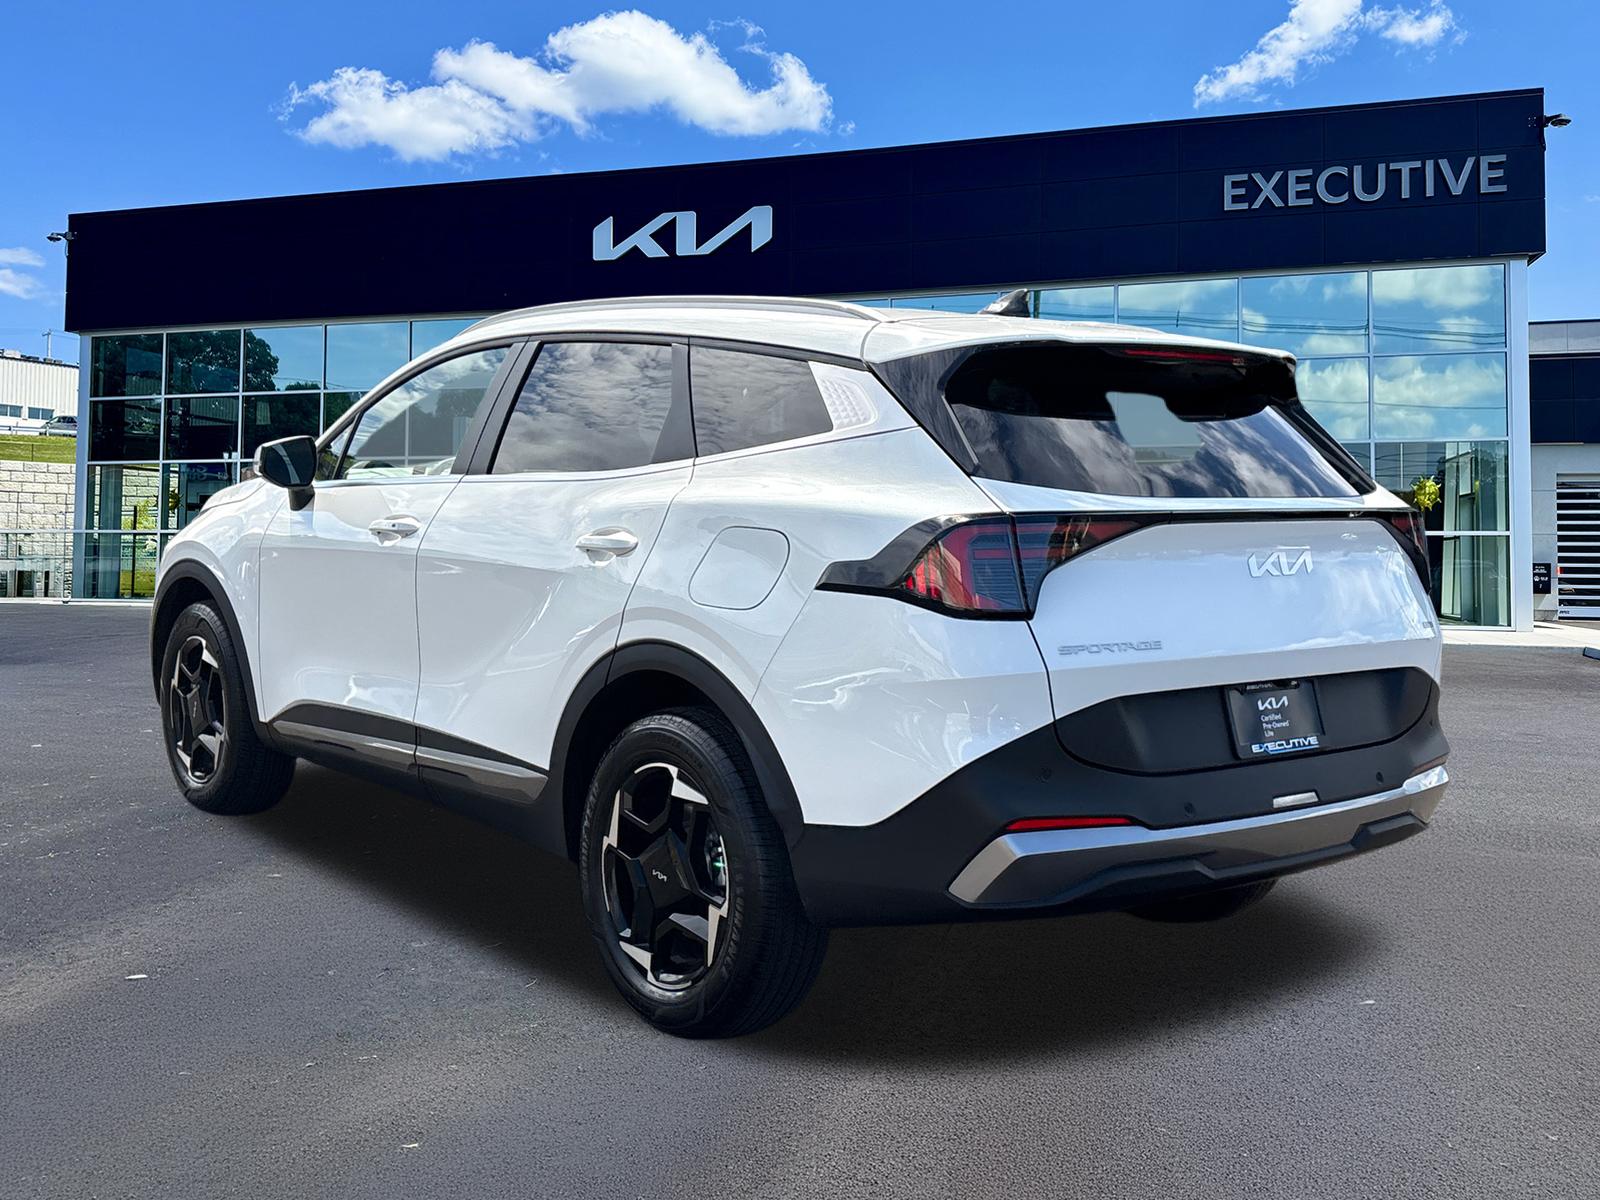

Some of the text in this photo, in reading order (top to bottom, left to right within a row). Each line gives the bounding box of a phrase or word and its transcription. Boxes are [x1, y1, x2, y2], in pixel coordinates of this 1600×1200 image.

[1224, 154, 1507, 211] EXECUTIVE
[593, 205, 772, 261] KIA
[1247, 549, 1313, 578] KIA
[1058, 640, 1162, 656] SPORTAGE
[1257, 696, 1288, 711] KIA
[1251, 736, 1318, 753] EXECUTIVE
